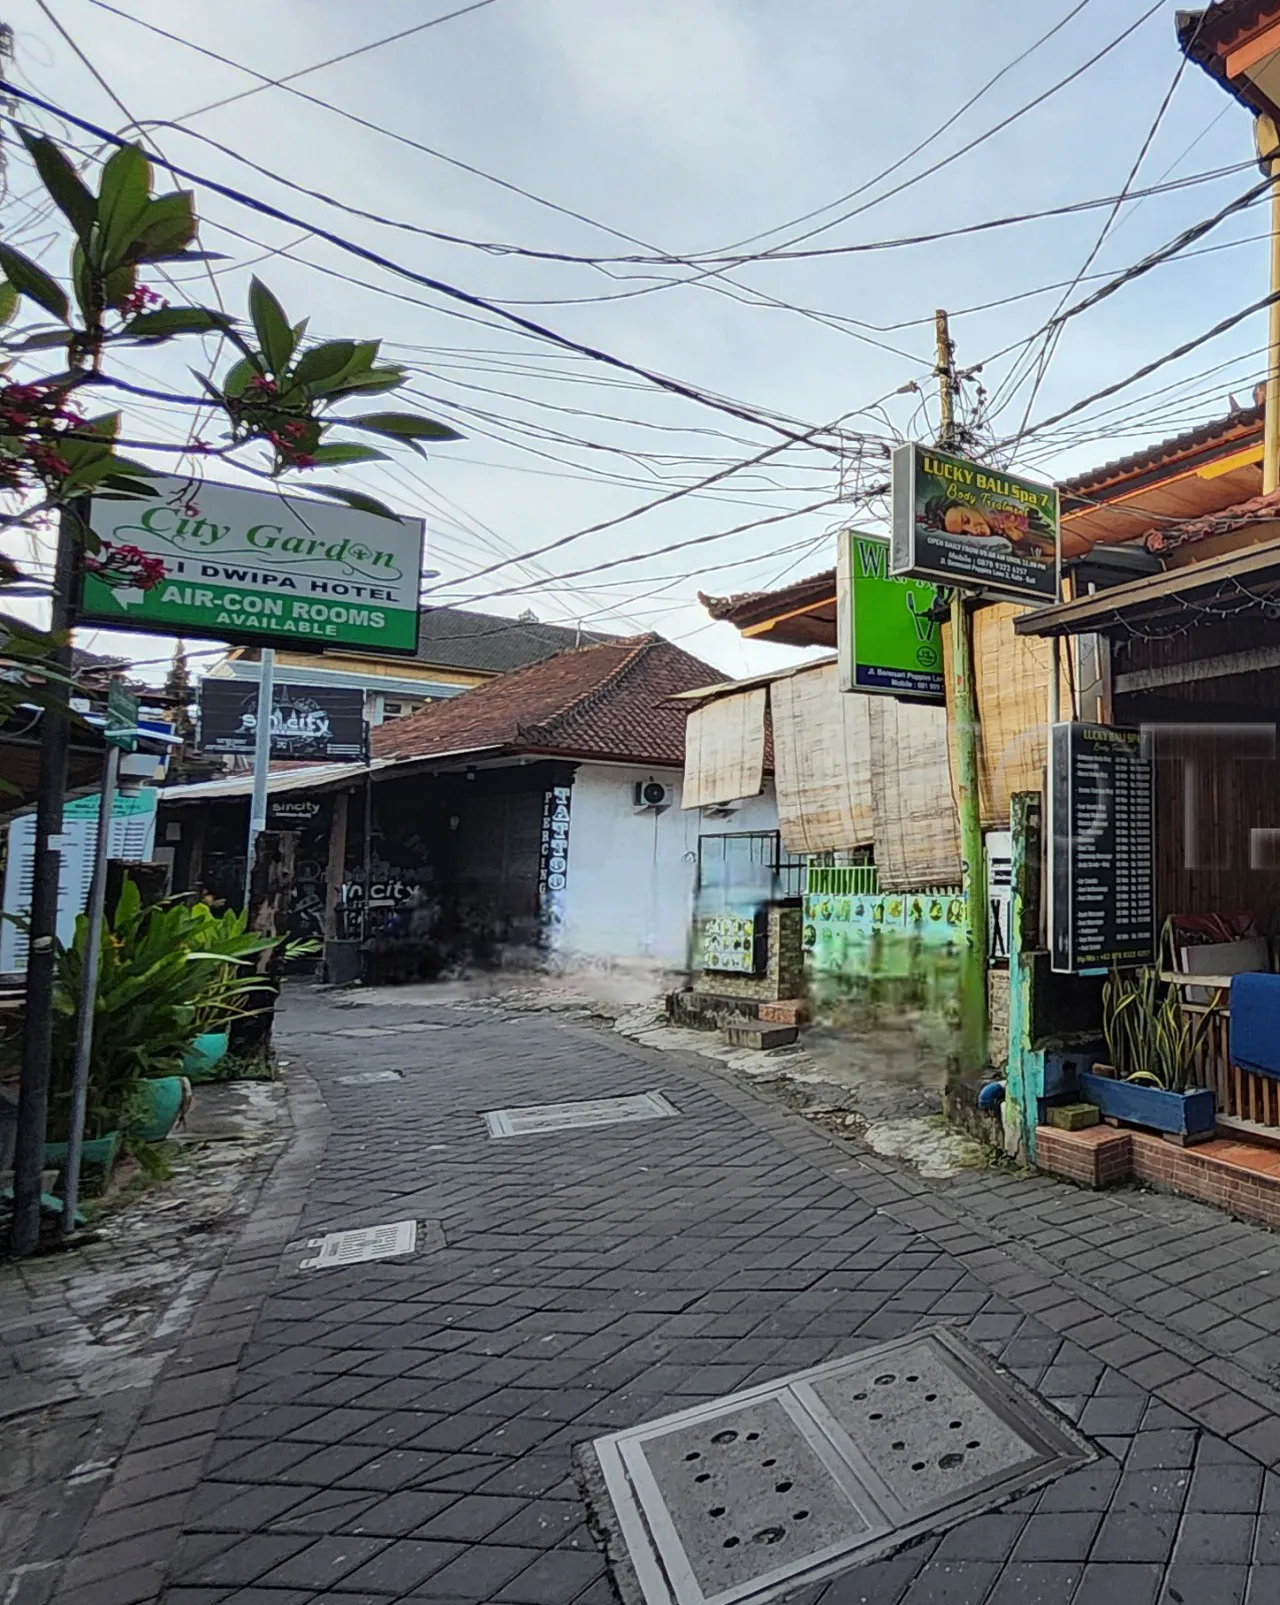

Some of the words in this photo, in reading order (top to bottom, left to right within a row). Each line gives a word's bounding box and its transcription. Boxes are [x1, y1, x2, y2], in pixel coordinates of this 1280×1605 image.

[923, 456, 974, 485] LUCKY
[976, 473, 1010, 496] BALI
[1011, 486, 1038, 506] Spa
[1040, 493, 1049, 507] 7
[946, 482, 977, 504] Body
[980, 491, 1029, 517] Treatment
[140, 505, 231, 546] City
[246, 524, 396, 569] Gardn
[927, 537, 944, 547] OPEN
[944, 540, 961, 551] DAILY
[949, 551, 972, 563] Mobile
[201, 565, 297, 590] DWIPA
[310, 578, 400, 602] HOTEL
[160, 585, 283, 616] AIR-CON
[292, 601, 385, 628] ROOMS
[216, 612, 337, 637] AVAILABLE
[241, 712, 279, 729] sn
[538, 791, 553, 894] PIERCING
[547, 786, 571, 891] TATTOO
